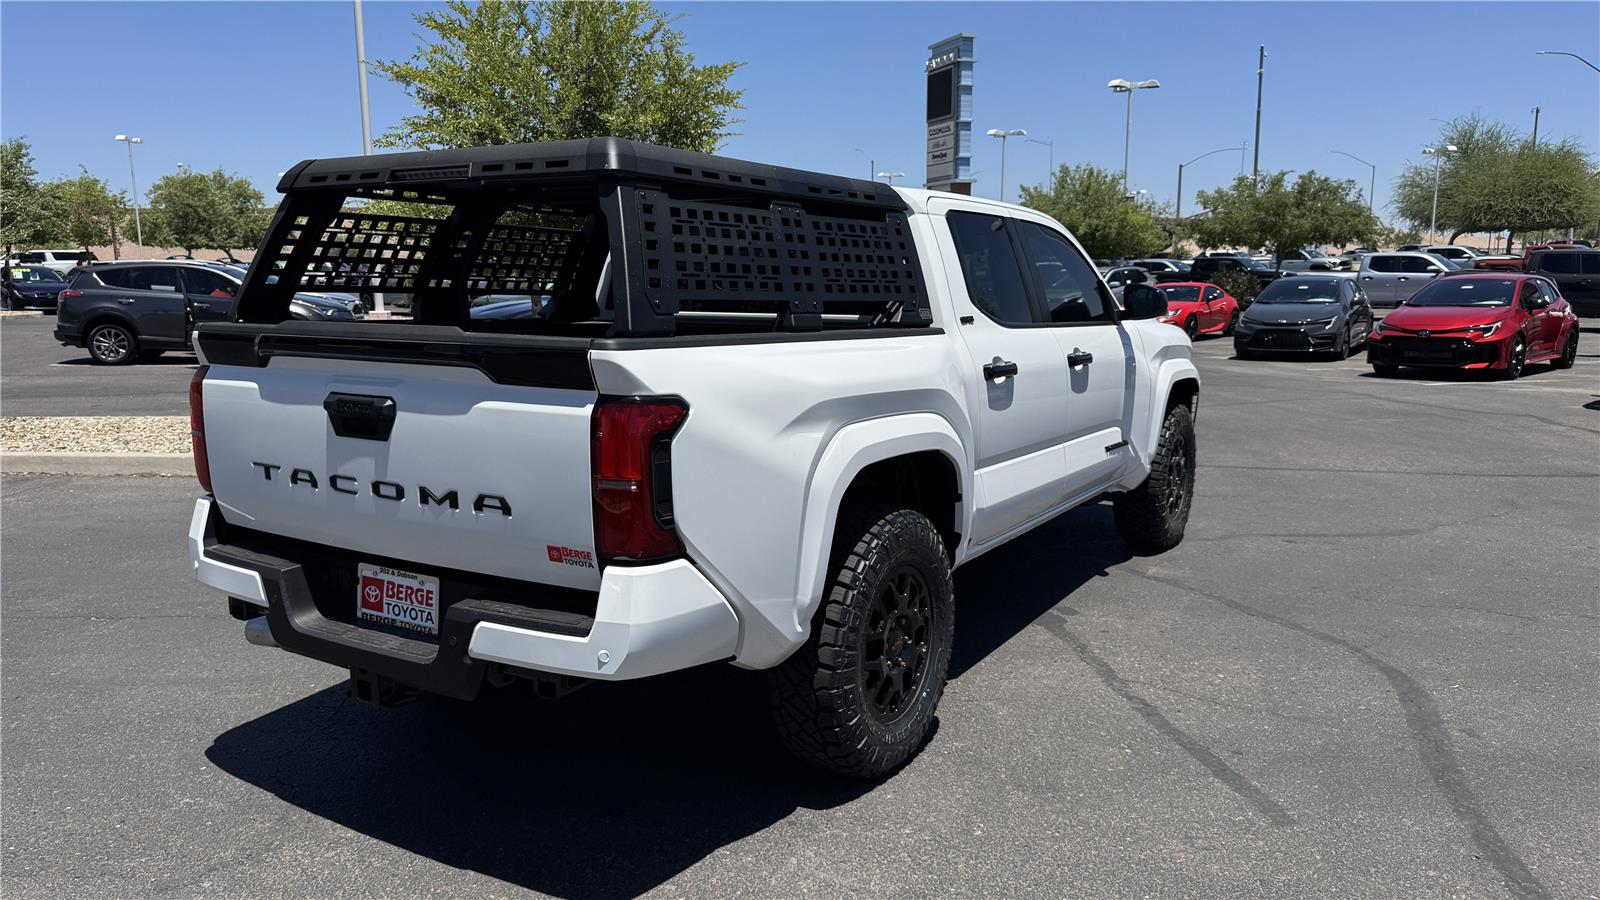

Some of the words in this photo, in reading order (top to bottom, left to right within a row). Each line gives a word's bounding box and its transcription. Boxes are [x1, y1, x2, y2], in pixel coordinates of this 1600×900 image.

[251, 461, 512, 517] TACOMA
[561, 546, 593, 560] BERGE
[564, 558, 595, 569] TOYOTA
[379, 567, 390, 575] 202
[397, 570, 418, 580] Dobson
[385, 580, 434, 608] BERGE
[361, 612, 398, 626] BERGE
[385, 602, 435, 625] TOYOTA
